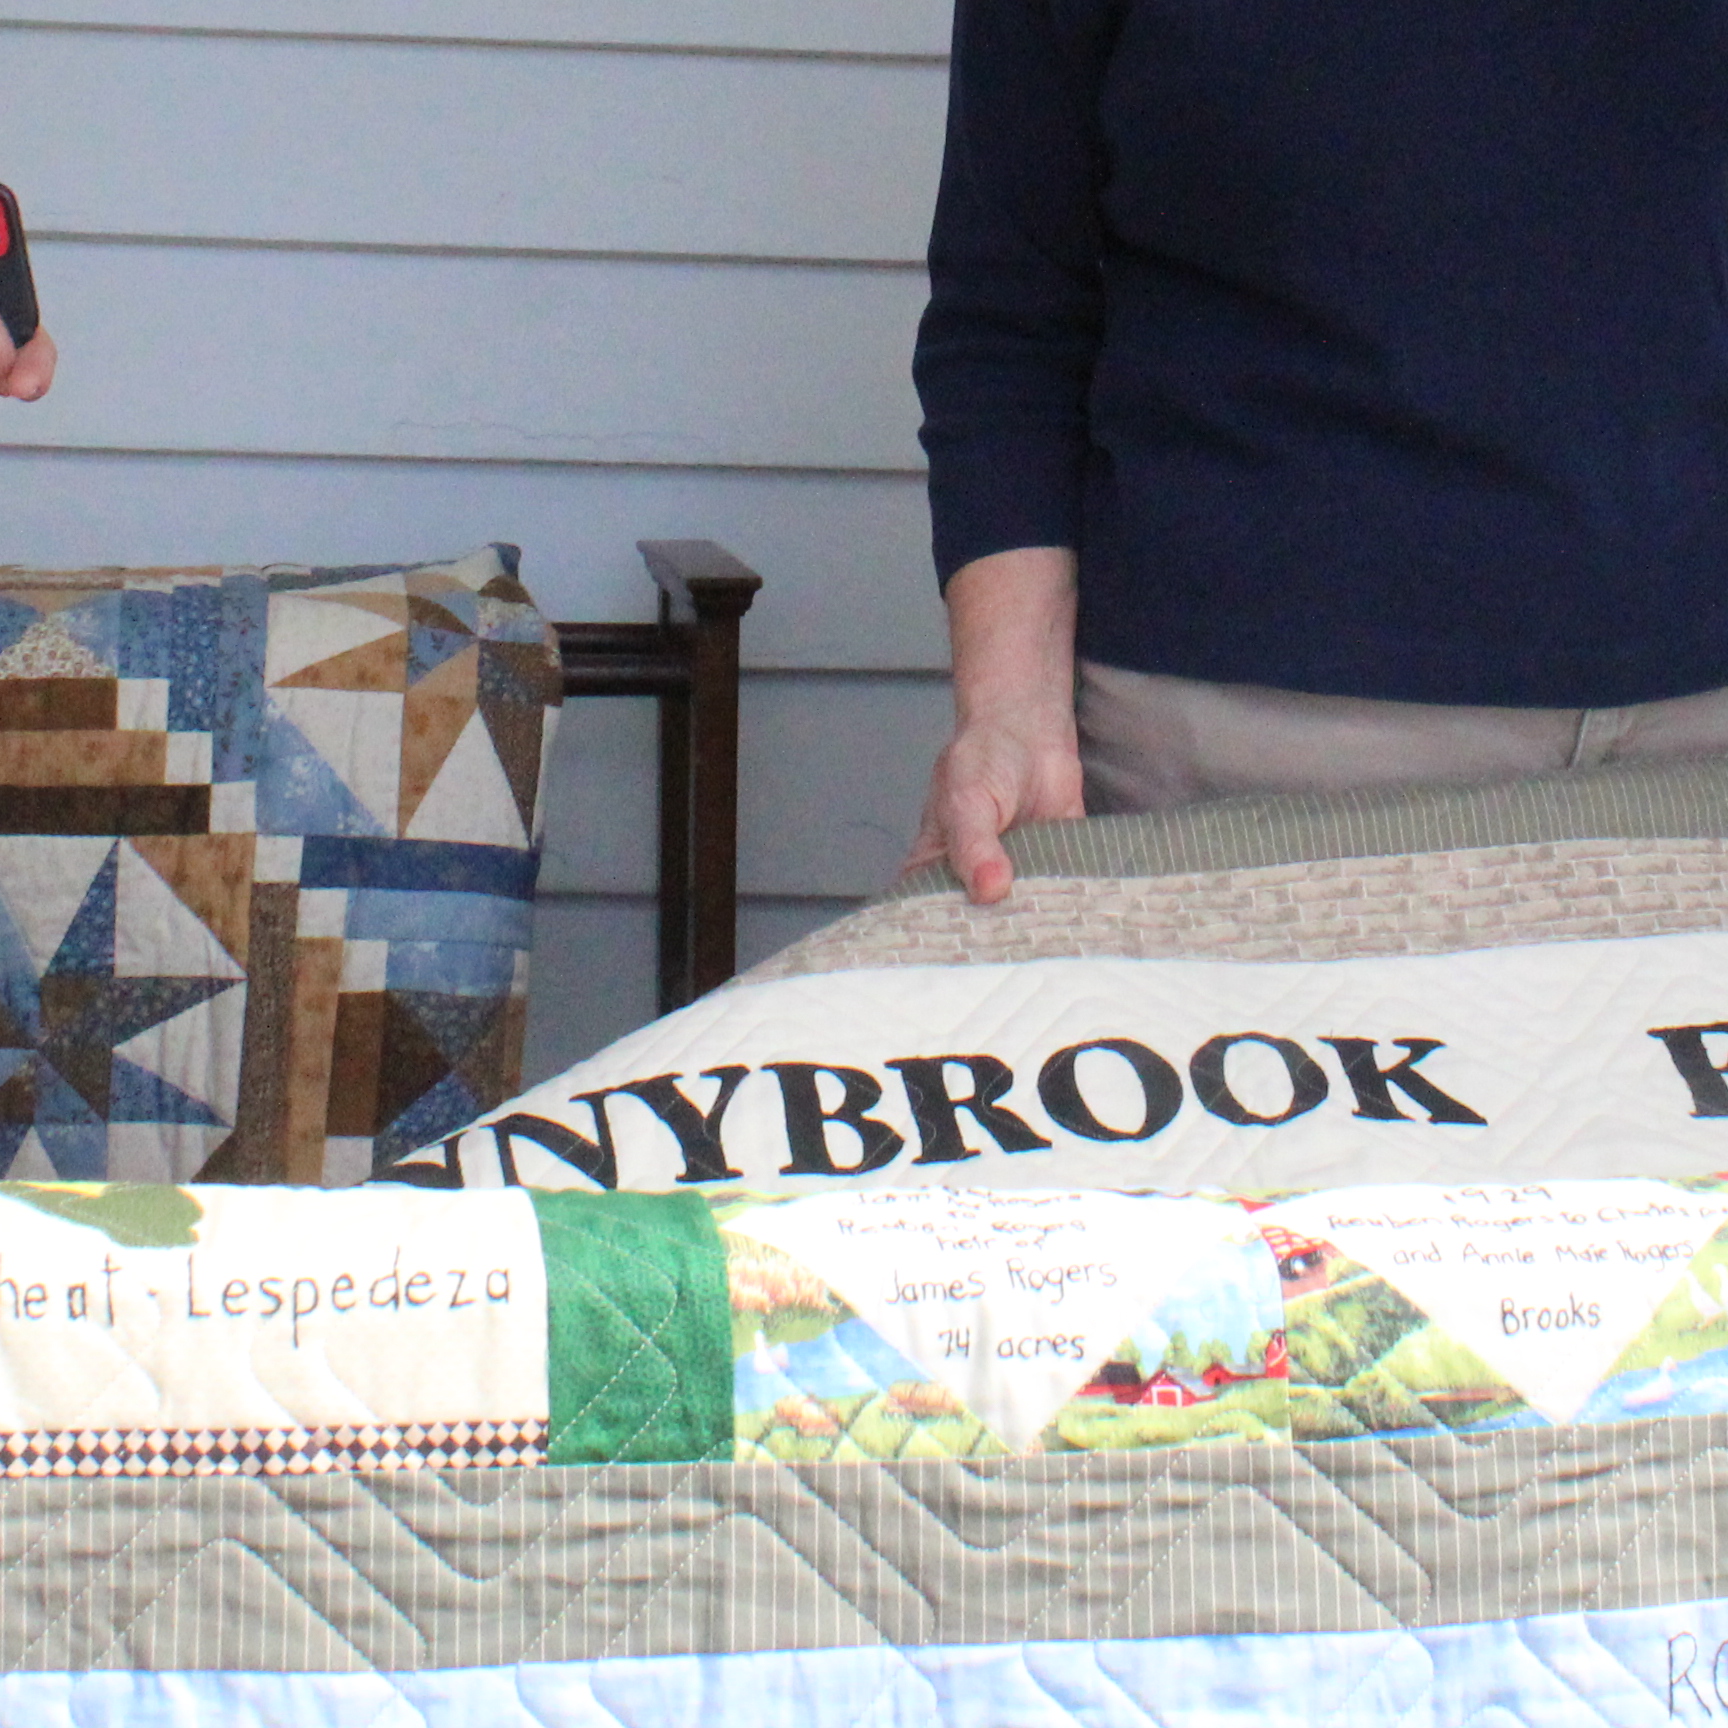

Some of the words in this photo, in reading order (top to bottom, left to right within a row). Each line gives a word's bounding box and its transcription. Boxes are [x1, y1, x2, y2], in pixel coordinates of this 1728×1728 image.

[1393, 1241, 1443, 1267] and
[184, 1244, 514, 1349] Lespedeza
[884, 1268, 986, 1304] James
[1006, 1256, 1118, 1306] Rogers
[1500, 1292, 1601, 1337] Brooks
[996, 1333, 1086, 1360] acres
